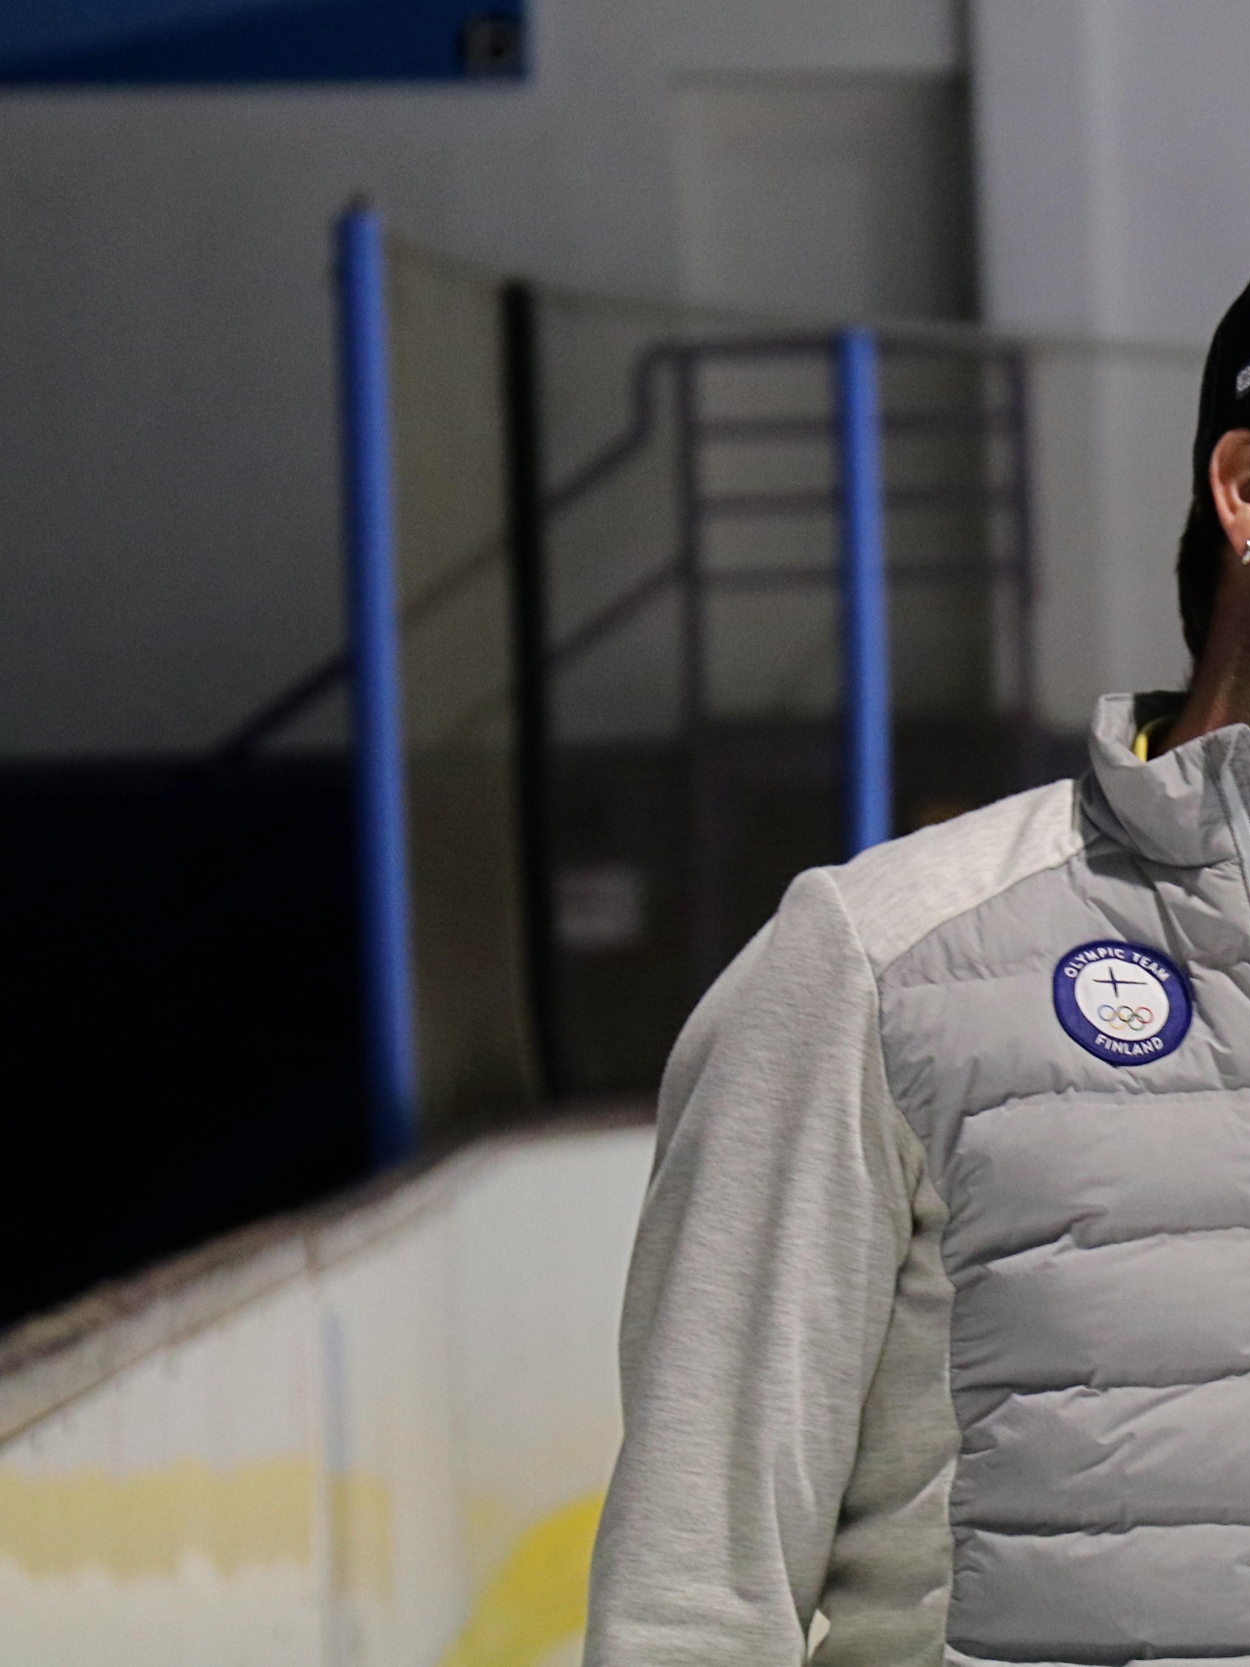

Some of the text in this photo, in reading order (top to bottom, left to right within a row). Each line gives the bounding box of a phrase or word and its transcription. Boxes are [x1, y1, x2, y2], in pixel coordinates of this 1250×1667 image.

[1064, 947, 1171, 982] OLYMPIC TEAM
[1095, 1033, 1164, 1056] FINLAND
